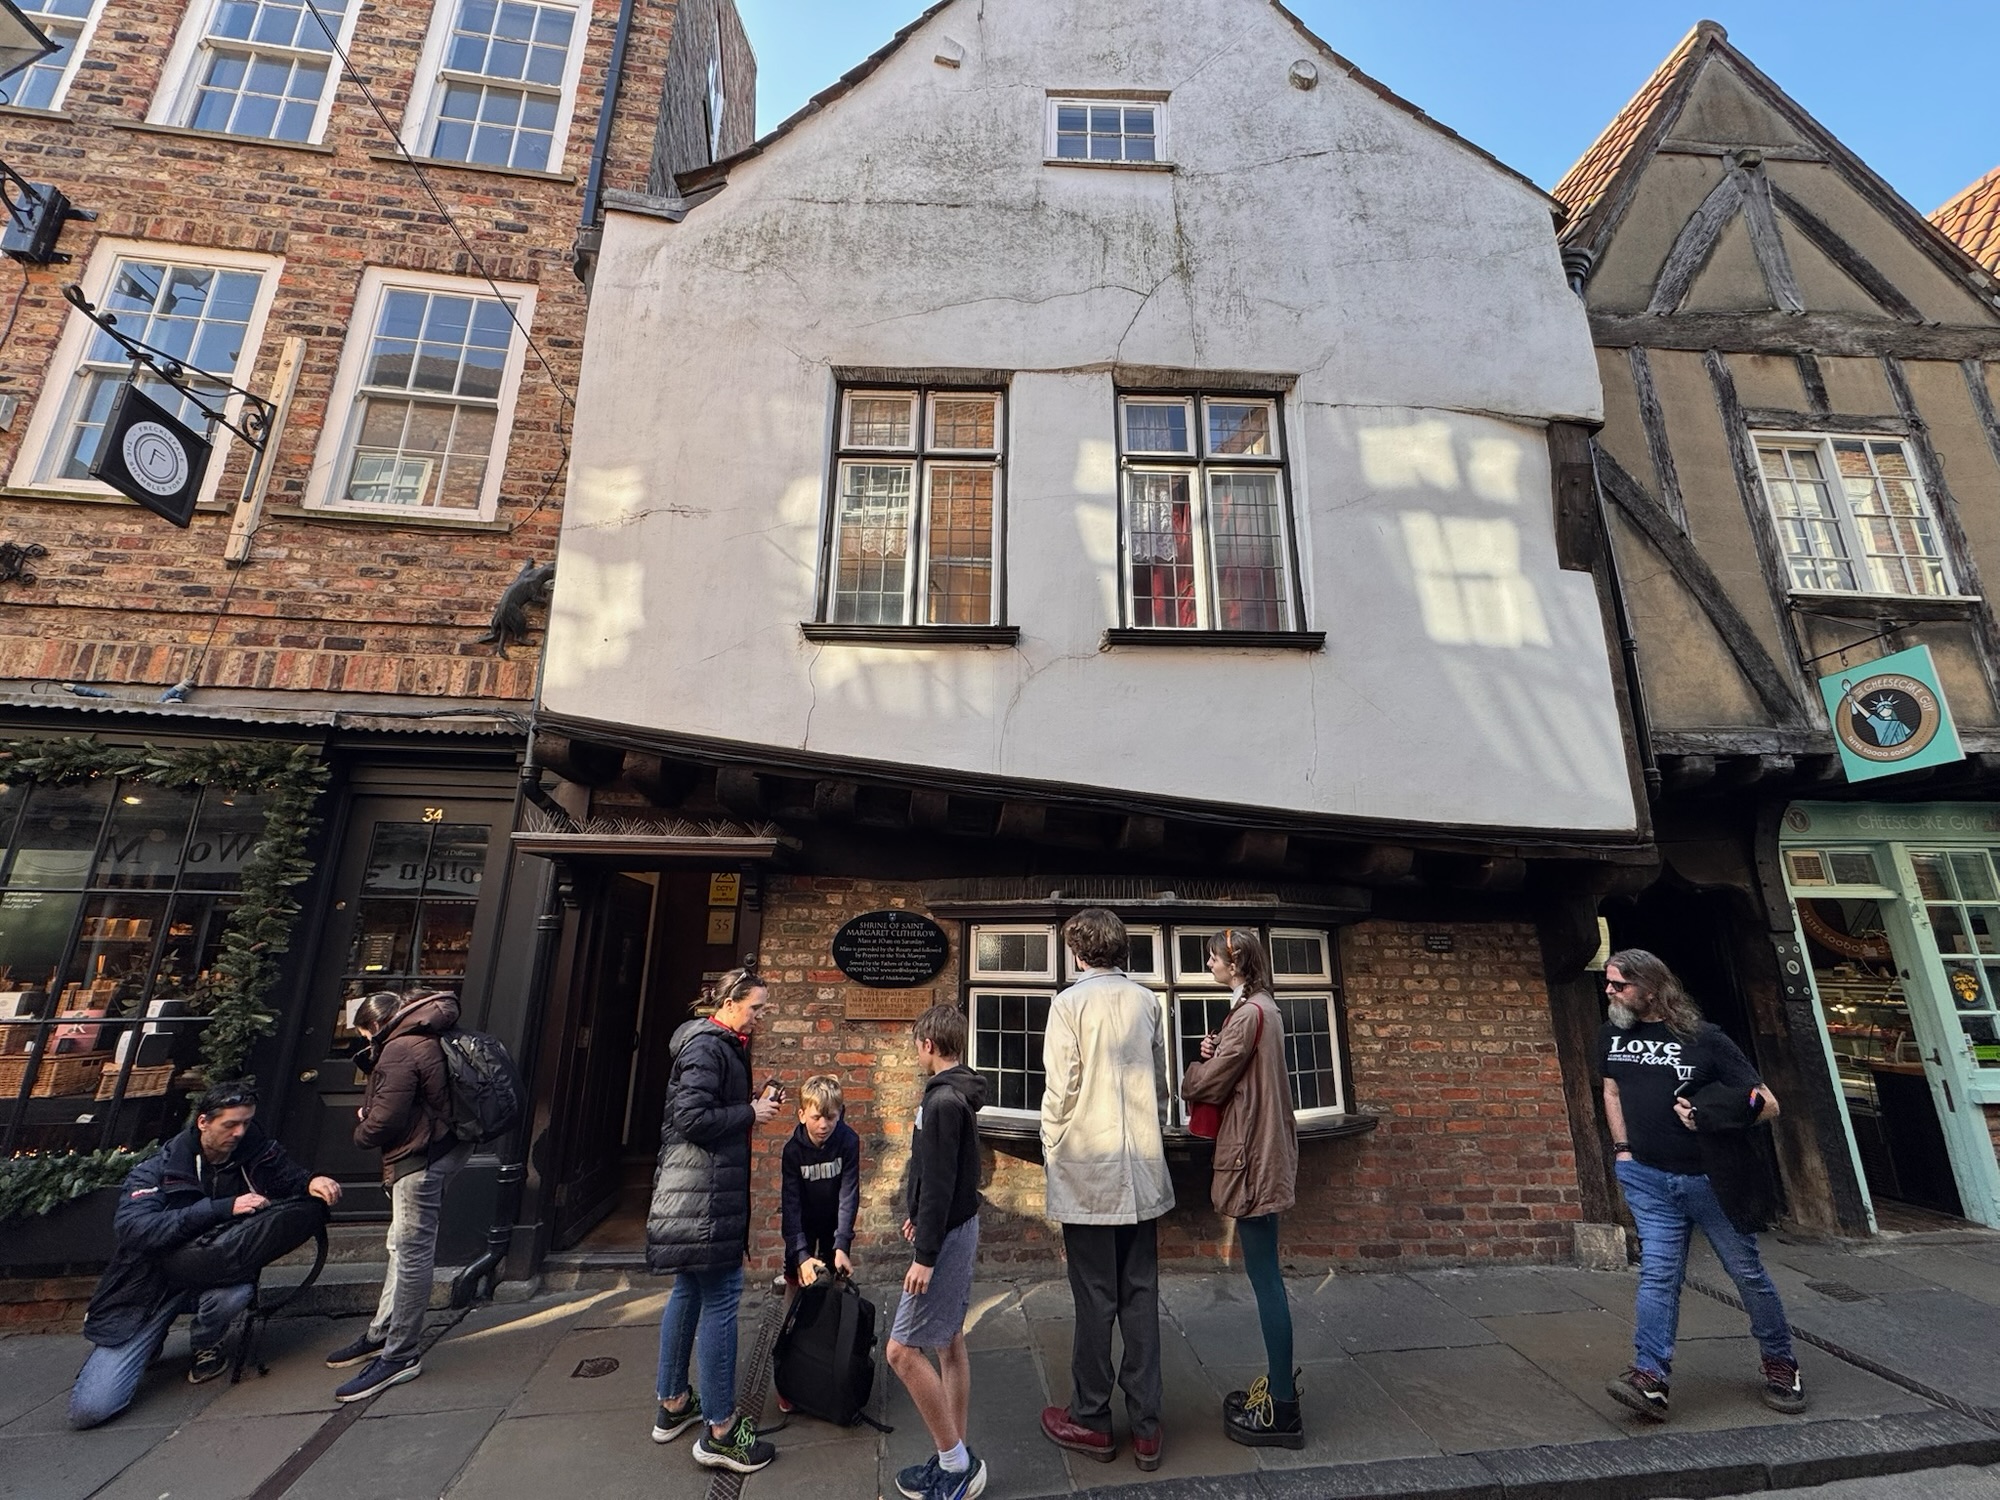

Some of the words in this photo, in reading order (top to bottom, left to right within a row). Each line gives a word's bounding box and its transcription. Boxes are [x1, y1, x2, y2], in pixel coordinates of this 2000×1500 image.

[138, 426, 185, 463] FRECKLEFACE
[129, 461, 167, 492] SHAMBLES
[168, 477, 183, 490] YORK
[1864, 679, 1922, 697] CHEESECAKE
[1920, 695, 1935, 712] GUY
[1847, 735, 1863, 751] TASTES
[422, 807, 443, 823] 34
[1856, 813, 1946, 831] CHEESECAKE
[1949, 815, 1978, 831] GUY
[714, 918, 730, 931] 35
[1802, 910, 1823, 934] TASTES
[1609, 1035, 1682, 1056] Love
[1640, 1052, 1681, 1066] Rocks
[1673, 1065, 1696, 1080] VI
